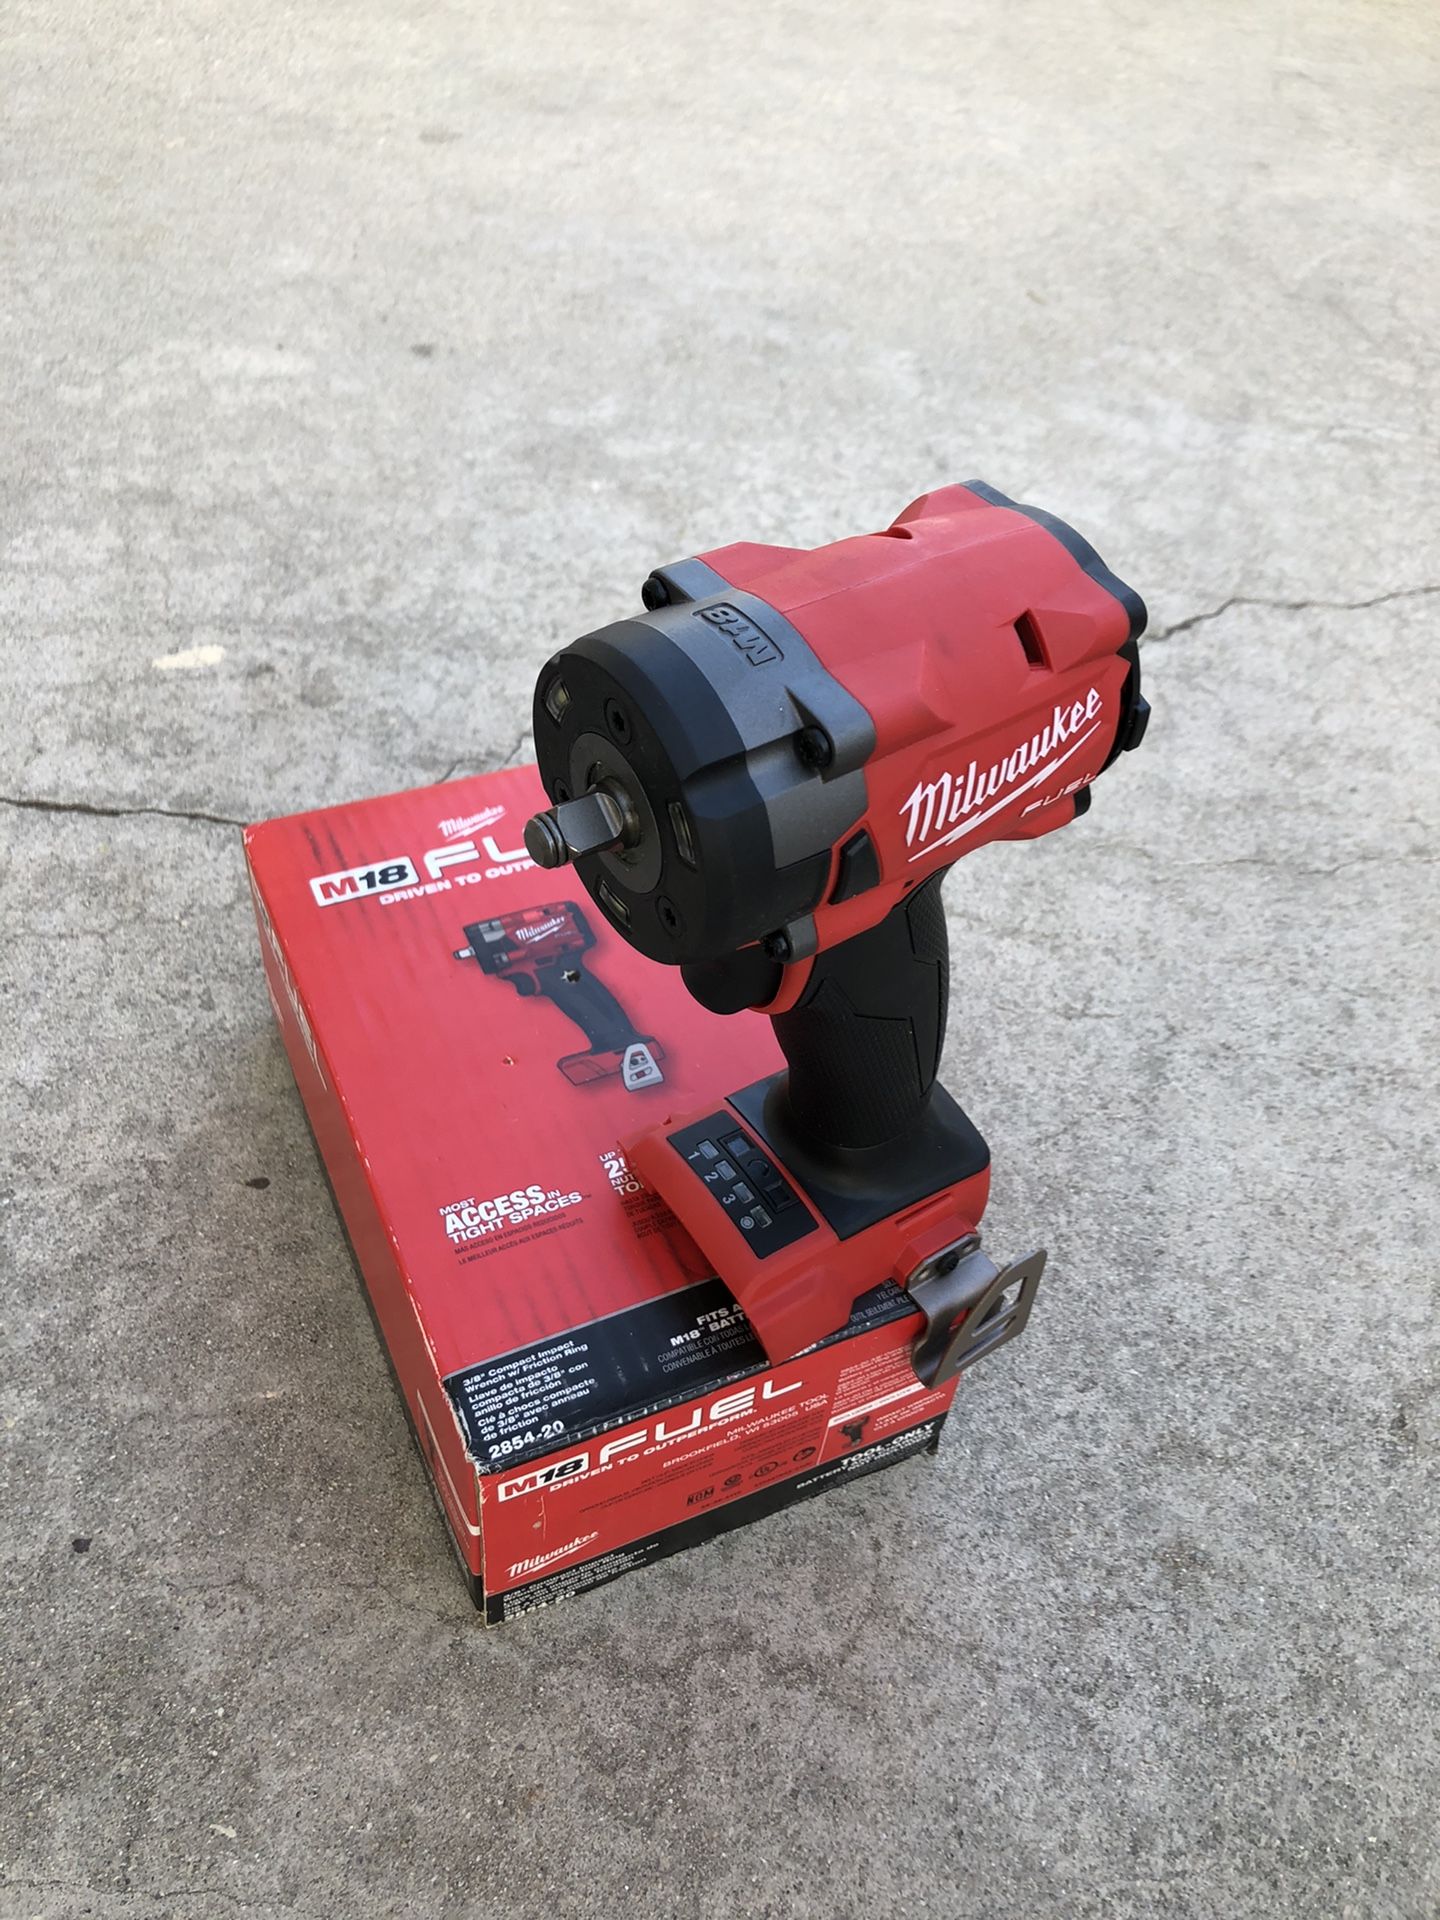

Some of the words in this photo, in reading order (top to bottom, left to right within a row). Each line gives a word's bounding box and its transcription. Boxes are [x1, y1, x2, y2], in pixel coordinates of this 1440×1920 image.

[701, 606, 776, 667] M18
[899, 688, 1103, 847] Milwaukee
[1020, 773, 1097, 818] FUEL
[437, 805, 506, 838] Milwaukee
[318, 864, 410, 900] M18
[379, 880, 453, 906] DRIVEN
[455, 872, 482, 887] TO
[515, 916, 565, 941] Milwaukee
[599, 1151, 616, 1162] UP
[688, 1151, 701, 1160] 1
[704, 1171, 720, 1183] 2
[439, 1197, 475, 1216] MOST
[445, 1185, 547, 1234] ACCESS
[547, 1189, 561, 1199] IN
[722, 1193, 737, 1205] 3
[448, 1216, 505, 1244] TIGHT
[696, 1307, 730, 1326] FITS
[463, 1372, 486, 1388] 3/8"
[488, 1354, 537, 1377] Compact
[538, 1340, 574, 1360] Impact
[465, 1374, 506, 1393] Wrench
[508, 1366, 521, 1379] w/
[522, 1353, 563, 1372] Friction
[564, 1343, 589, 1358] Ring
[657, 1339, 704, 1363] COMPATIBLE
[702, 1334, 720, 1346] CON
[662, 1346, 711, 1373] CONVENABLE
[717, 1335, 746, 1353] TOUTES
[468, 1387, 498, 1403] Llave
[499, 1381, 514, 1393] de
[515, 1364, 559, 1386] impacto
[471, 1385, 527, 1410] compacta
[527, 1377, 542, 1390] de
[543, 1369, 566, 1384] 3/8"
[568, 1362, 589, 1374] con
[474, 1401, 504, 1418] anillo
[505, 1394, 520, 1406] de
[521, 1379, 563, 1400] fricción
[477, 1411, 497, 1428] Clé
[508, 1399, 542, 1417] chocs
[542, 1377, 596, 1404] compacte
[480, 1424, 496, 1436] de
[497, 1413, 521, 1429] 3/8"
[523, 1404, 550, 1420] avec
[551, 1388, 590, 1408] anneau
[483, 1431, 498, 1442] de
[499, 1416, 540, 1437] friction
[726, 1404, 797, 1437] MILWAUKEE
[799, 1393, 830, 1409] TOOL
[488, 1419, 565, 1460] 2854-20
[503, 1457, 585, 1498] M18
[599, 1379, 803, 1466] FUEL
[550, 1463, 613, 1493] DRIVEN
[617, 1452, 640, 1466] TO
[643, 1408, 758, 1457] OUTPERFORM.
[663, 1434, 742, 1469] BROOKFIELD,
[745, 1424, 761, 1436] WI
[805, 1399, 829, 1413] USA
[841, 1421, 937, 1467] TOOL-ONLY
[796, 1464, 848, 1490] BATTERY
[505, 1530, 600, 1578] Milwaukee
